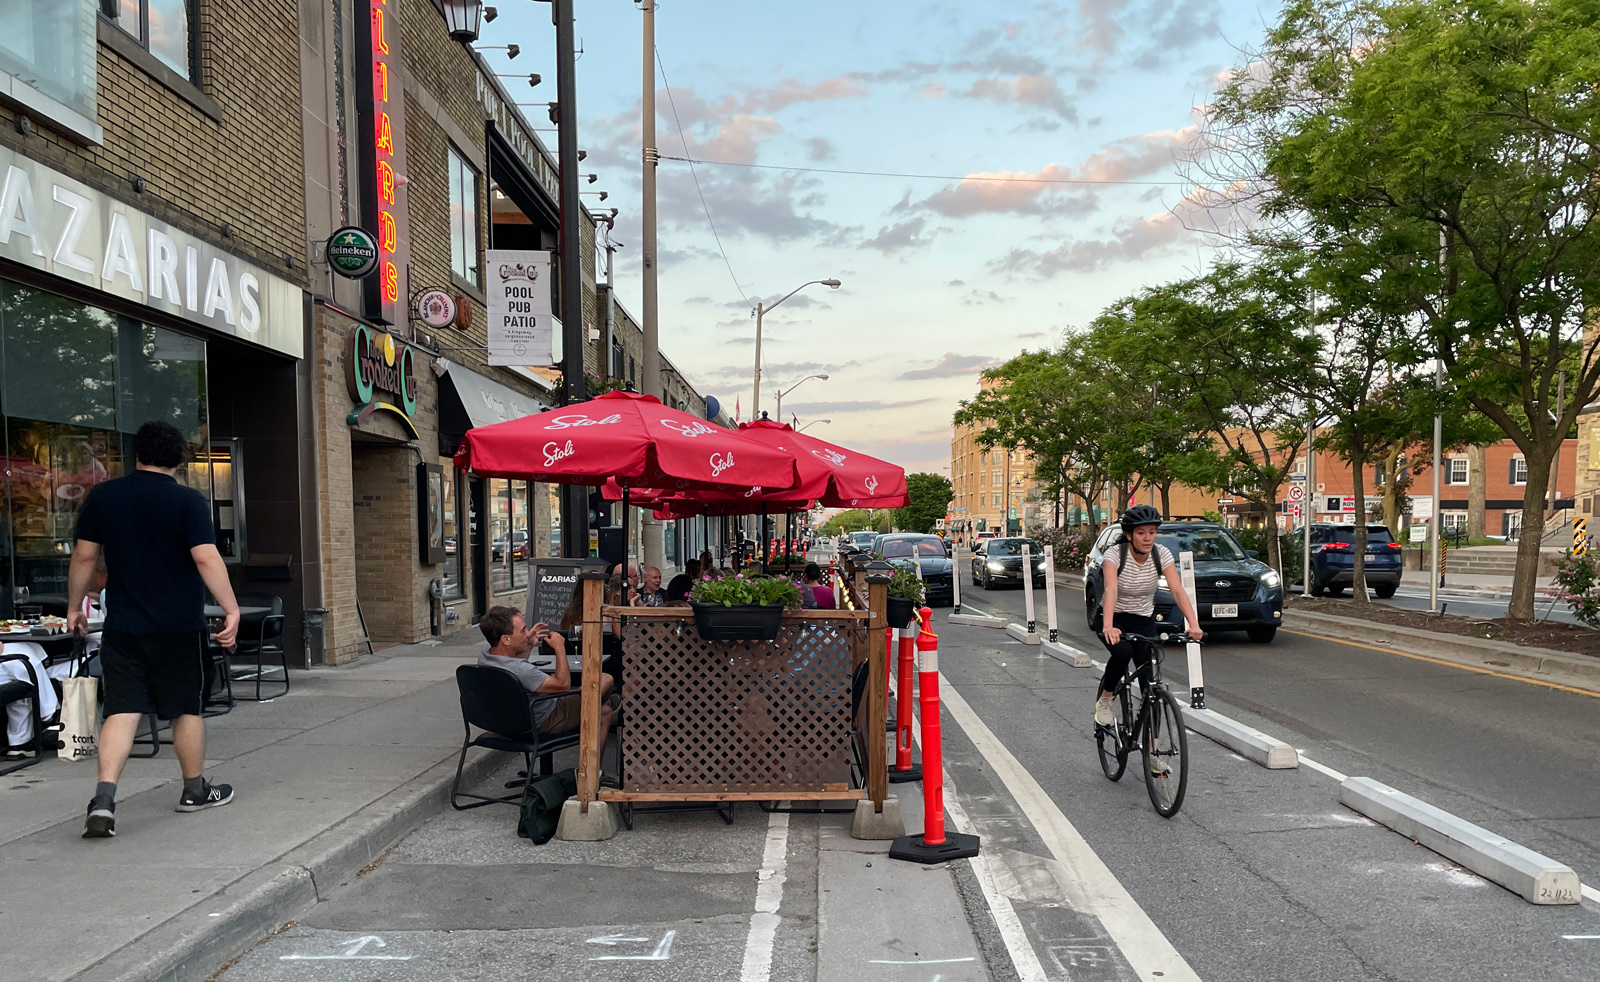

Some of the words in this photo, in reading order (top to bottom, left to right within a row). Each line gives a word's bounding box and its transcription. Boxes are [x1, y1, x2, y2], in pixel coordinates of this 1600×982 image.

[0, 164, 262, 333] AZARIAS
[330, 245, 373, 257] Heineken
[505, 286, 534, 299] POOL
[508, 301, 531, 313] PUB
[503, 315, 536, 328] PATIO
[354, 324, 401, 404] Crooked
[401, 344, 418, 416] Cue
[544, 414, 622, 430] Stoli
[660, 419, 718, 437] Stoli
[542, 440, 575, 467] Stoli
[709, 452, 735, 477] Stoli
[541, 575, 577, 583] AZARIAS
